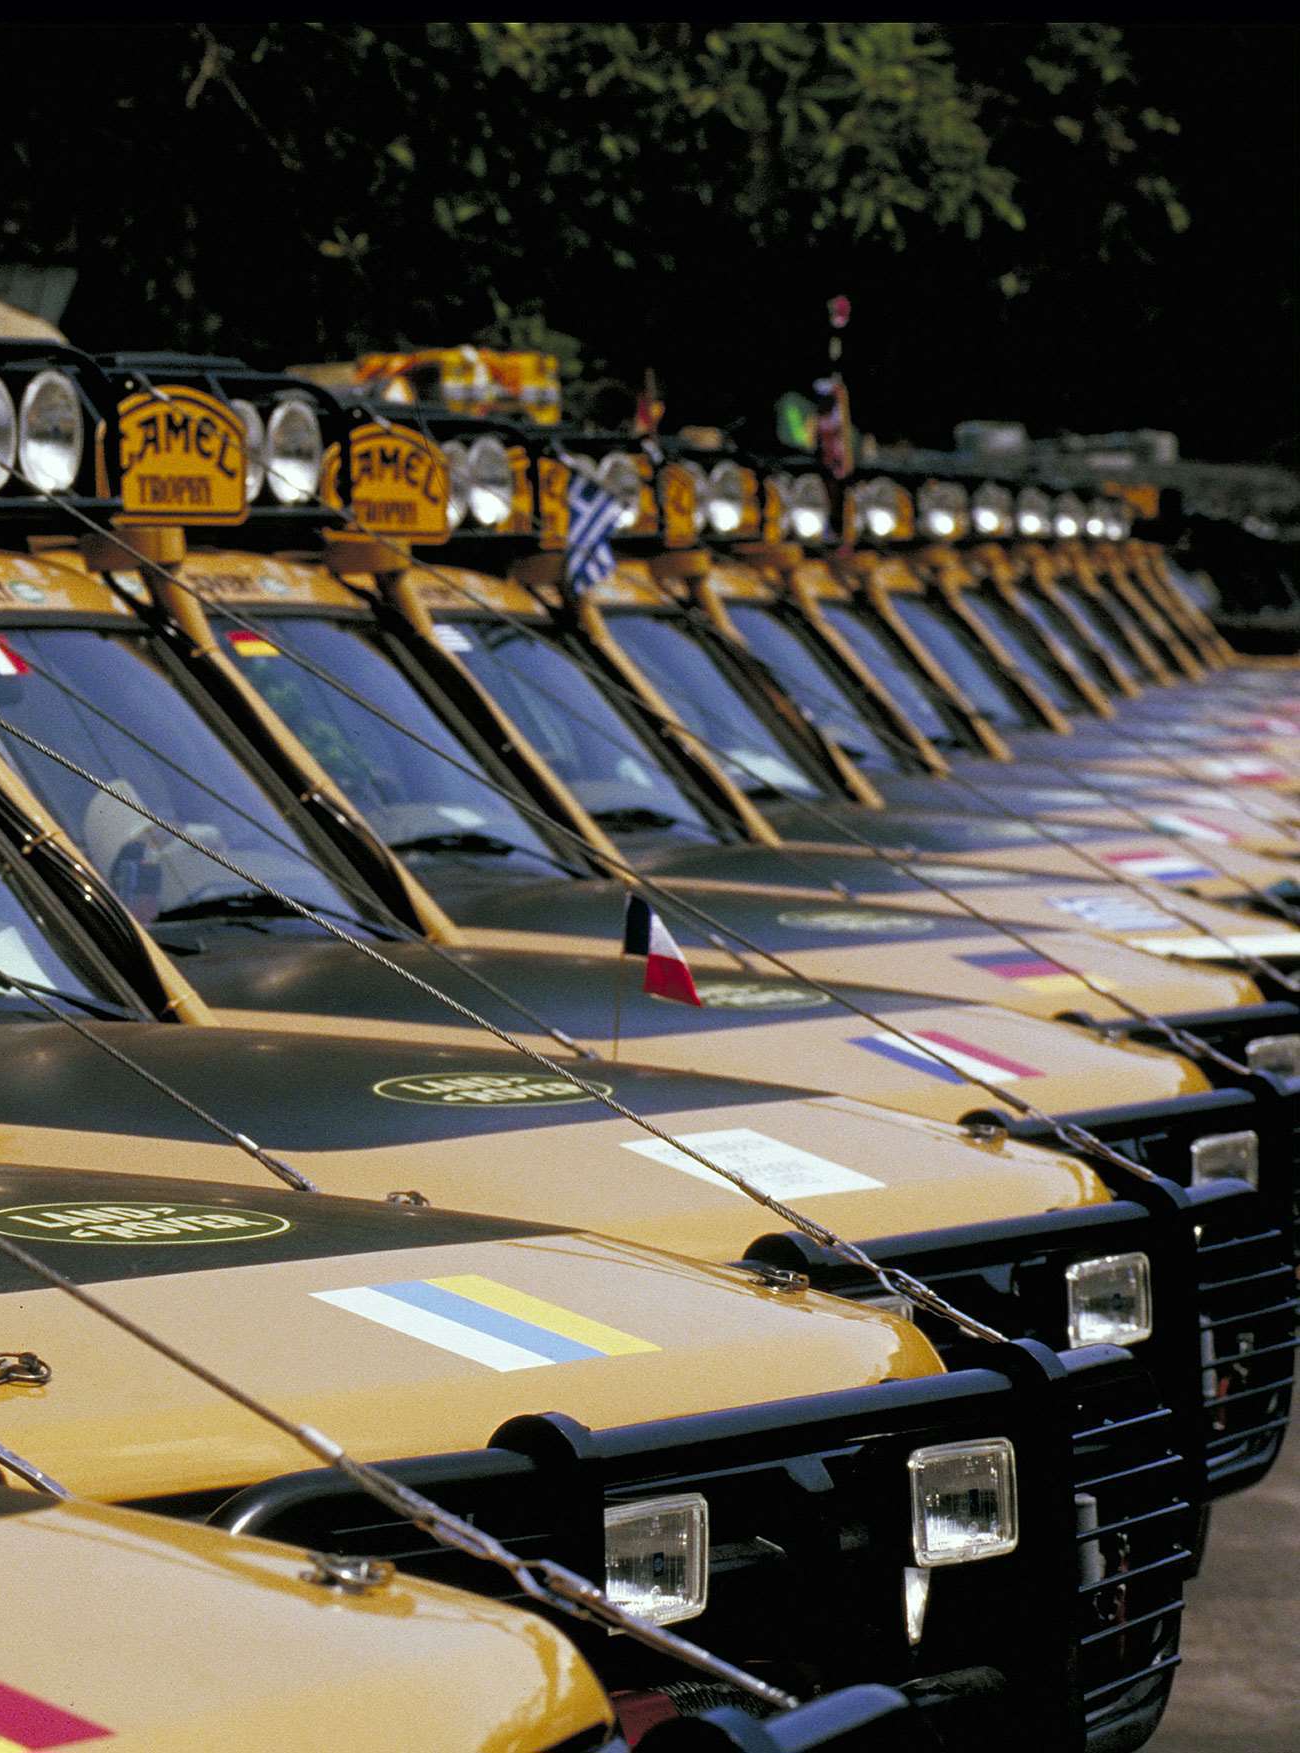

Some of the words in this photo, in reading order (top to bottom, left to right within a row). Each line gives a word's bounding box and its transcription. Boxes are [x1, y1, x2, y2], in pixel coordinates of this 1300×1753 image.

[351, 446, 439, 505] AMEL
[399, 1076, 513, 1095] LAND
[8, 1206, 155, 1229] LAND
[83, 1214, 268, 1239] ROVER
